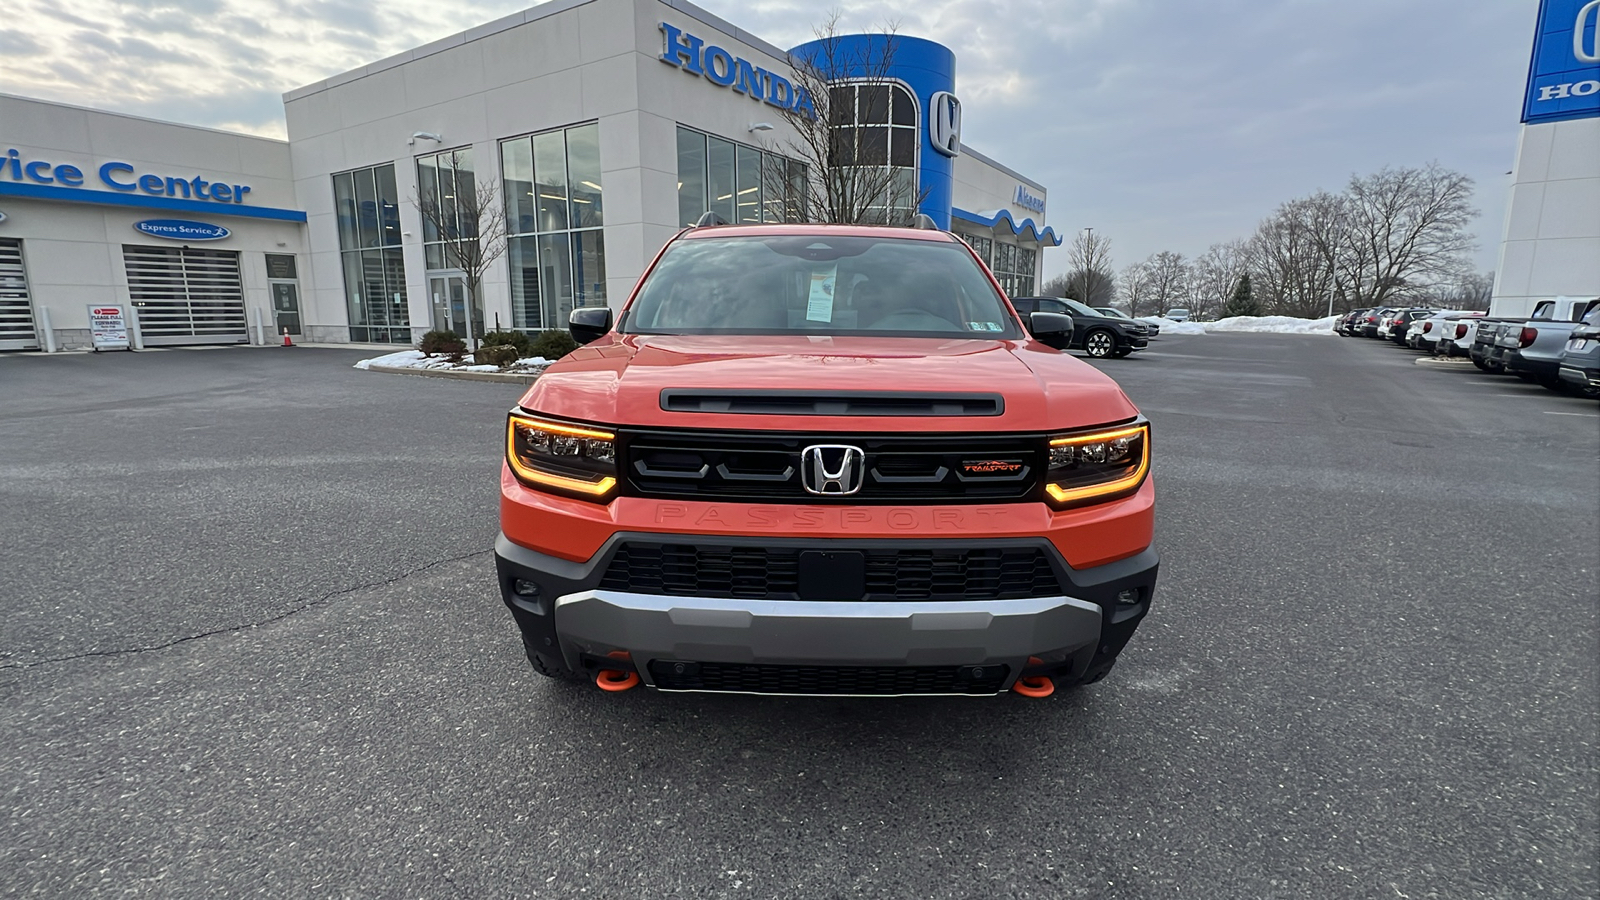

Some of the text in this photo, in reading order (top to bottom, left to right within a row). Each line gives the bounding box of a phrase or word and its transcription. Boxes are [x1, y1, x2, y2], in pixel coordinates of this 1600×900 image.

[658, 22, 819, 121] HONDA
[99, 161, 251, 203] Center
[141, 223, 212, 235] Express Service
[964, 464, 1021, 472] TRAILSPORT
[654, 502, 1007, 529] PASSPORT
